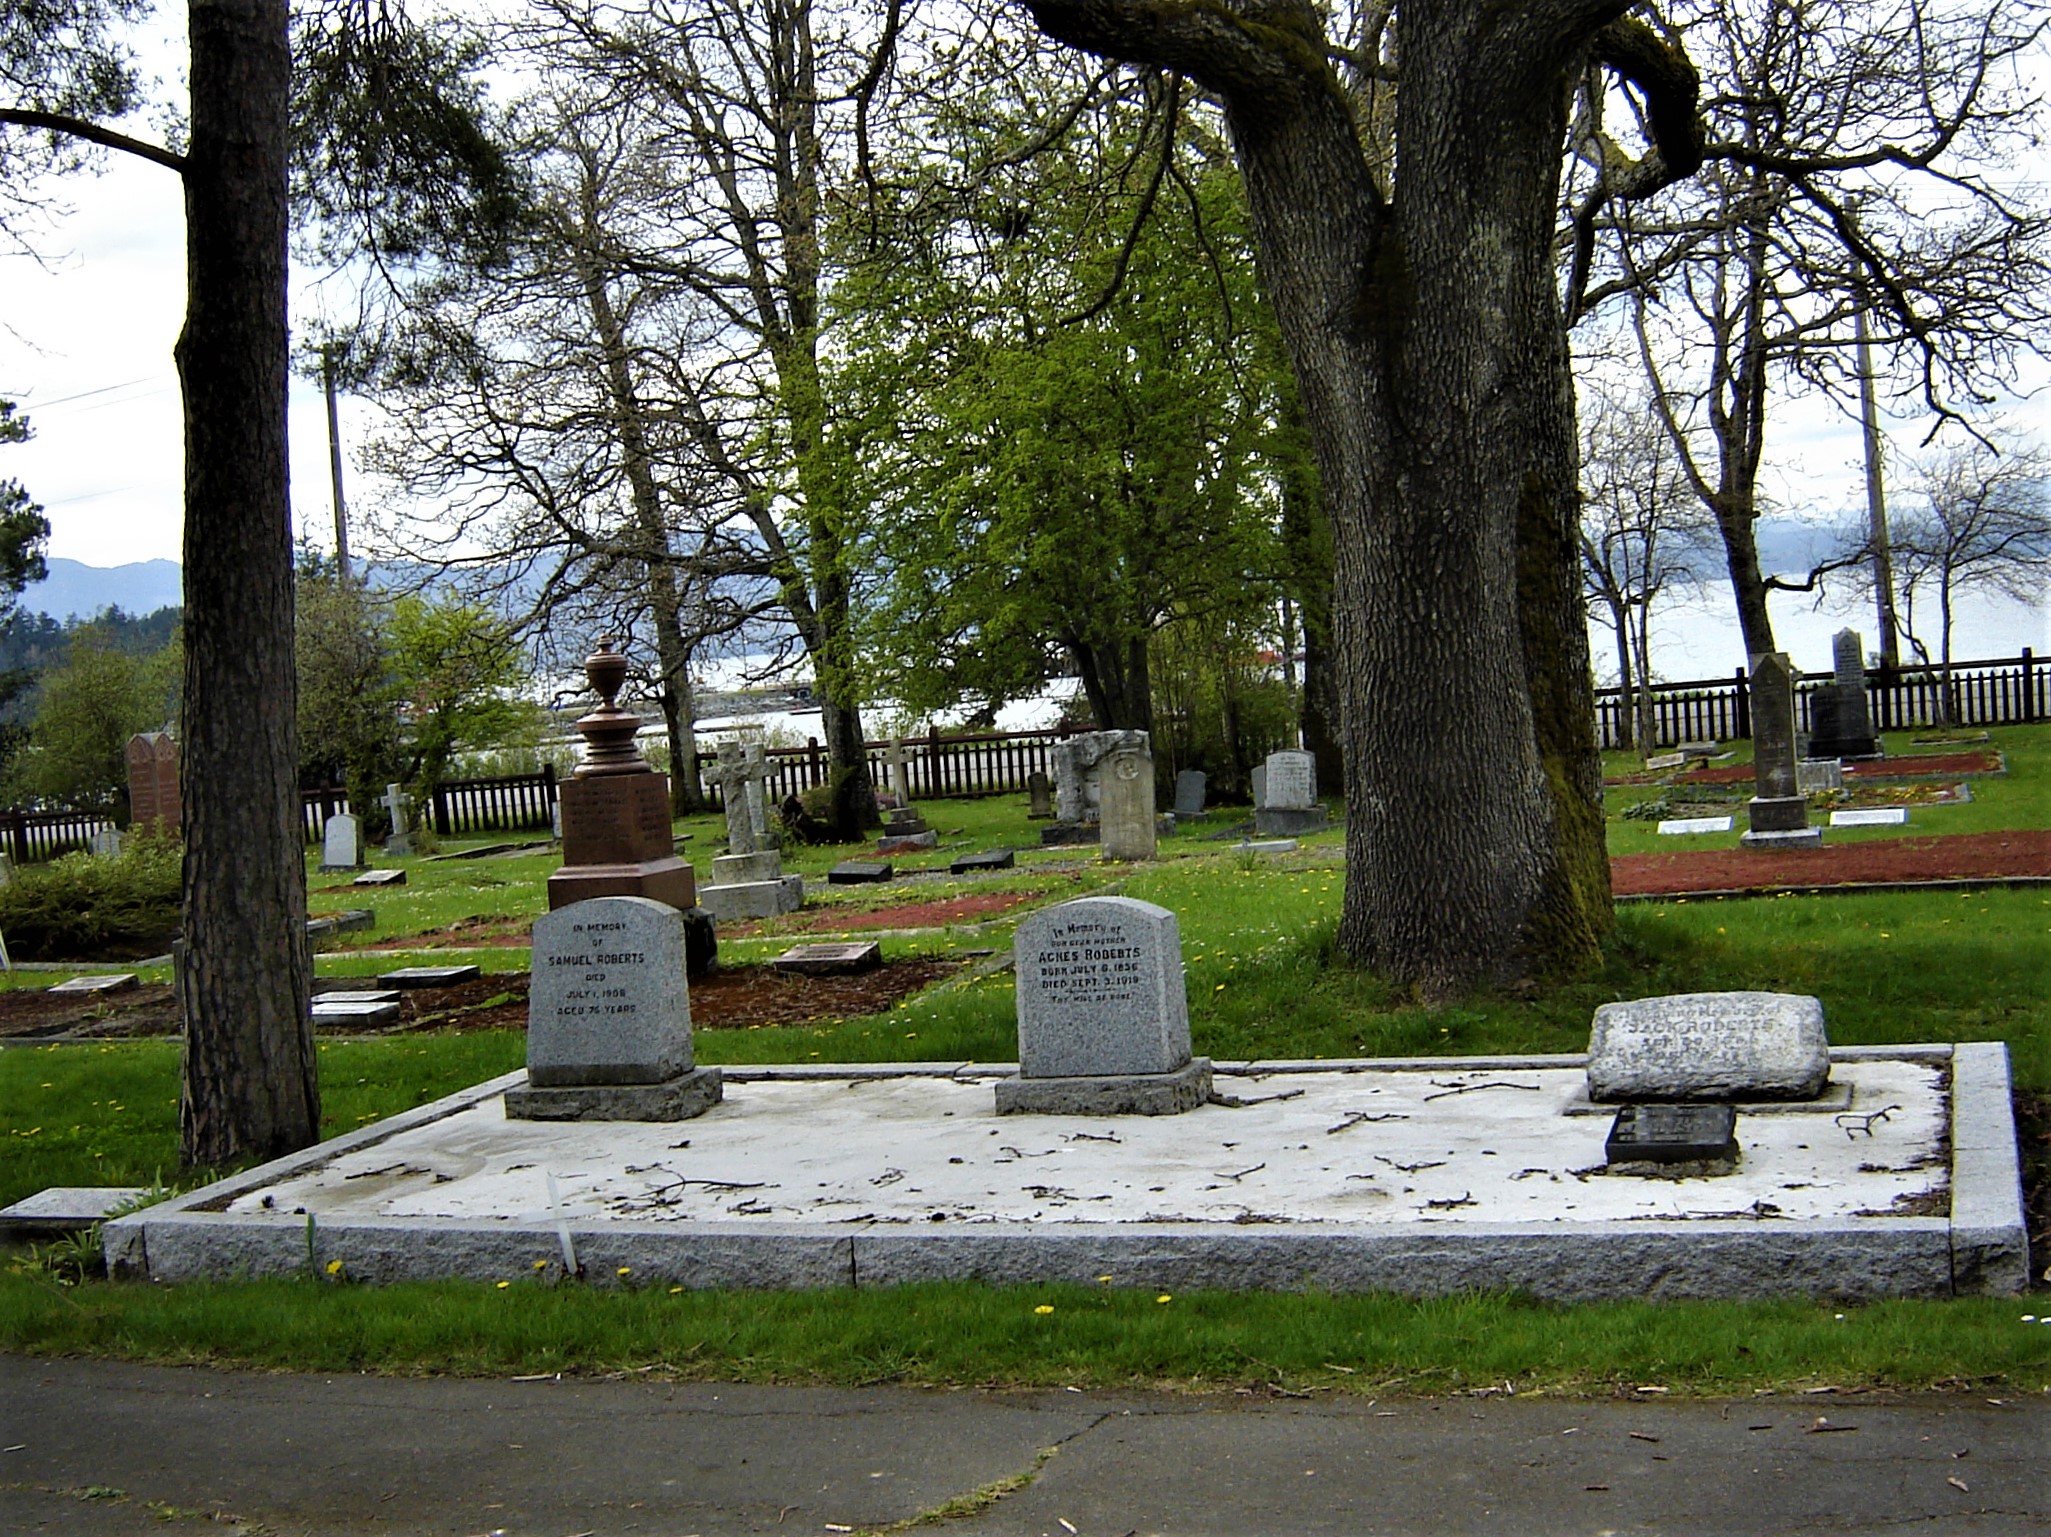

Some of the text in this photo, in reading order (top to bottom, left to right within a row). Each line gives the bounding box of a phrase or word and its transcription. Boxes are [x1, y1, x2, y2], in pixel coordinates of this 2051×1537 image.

[573, 923, 626, 932] IN MEMORY
[1053, 923, 1121, 938] In Memory of
[592, 939, 603, 947] OF
[1051, 937, 1126, 947] OUR DEAR MOTHER
[549, 953, 645, 966] SAMUEL ROBERTS
[1039, 947, 1141, 963] AGNES ROBERTS
[1041, 967, 1068, 976] BORN
[1070, 965, 1097, 975] JULY
[586, 974, 606, 982] DIED
[1042, 980, 1067, 989] DIED
[566, 990, 590, 999] JULY
[557, 1007, 584, 1016] AGED
[605, 1005, 636, 1014] YEARS
[1628, 1021, 1683, 1034] JACK
